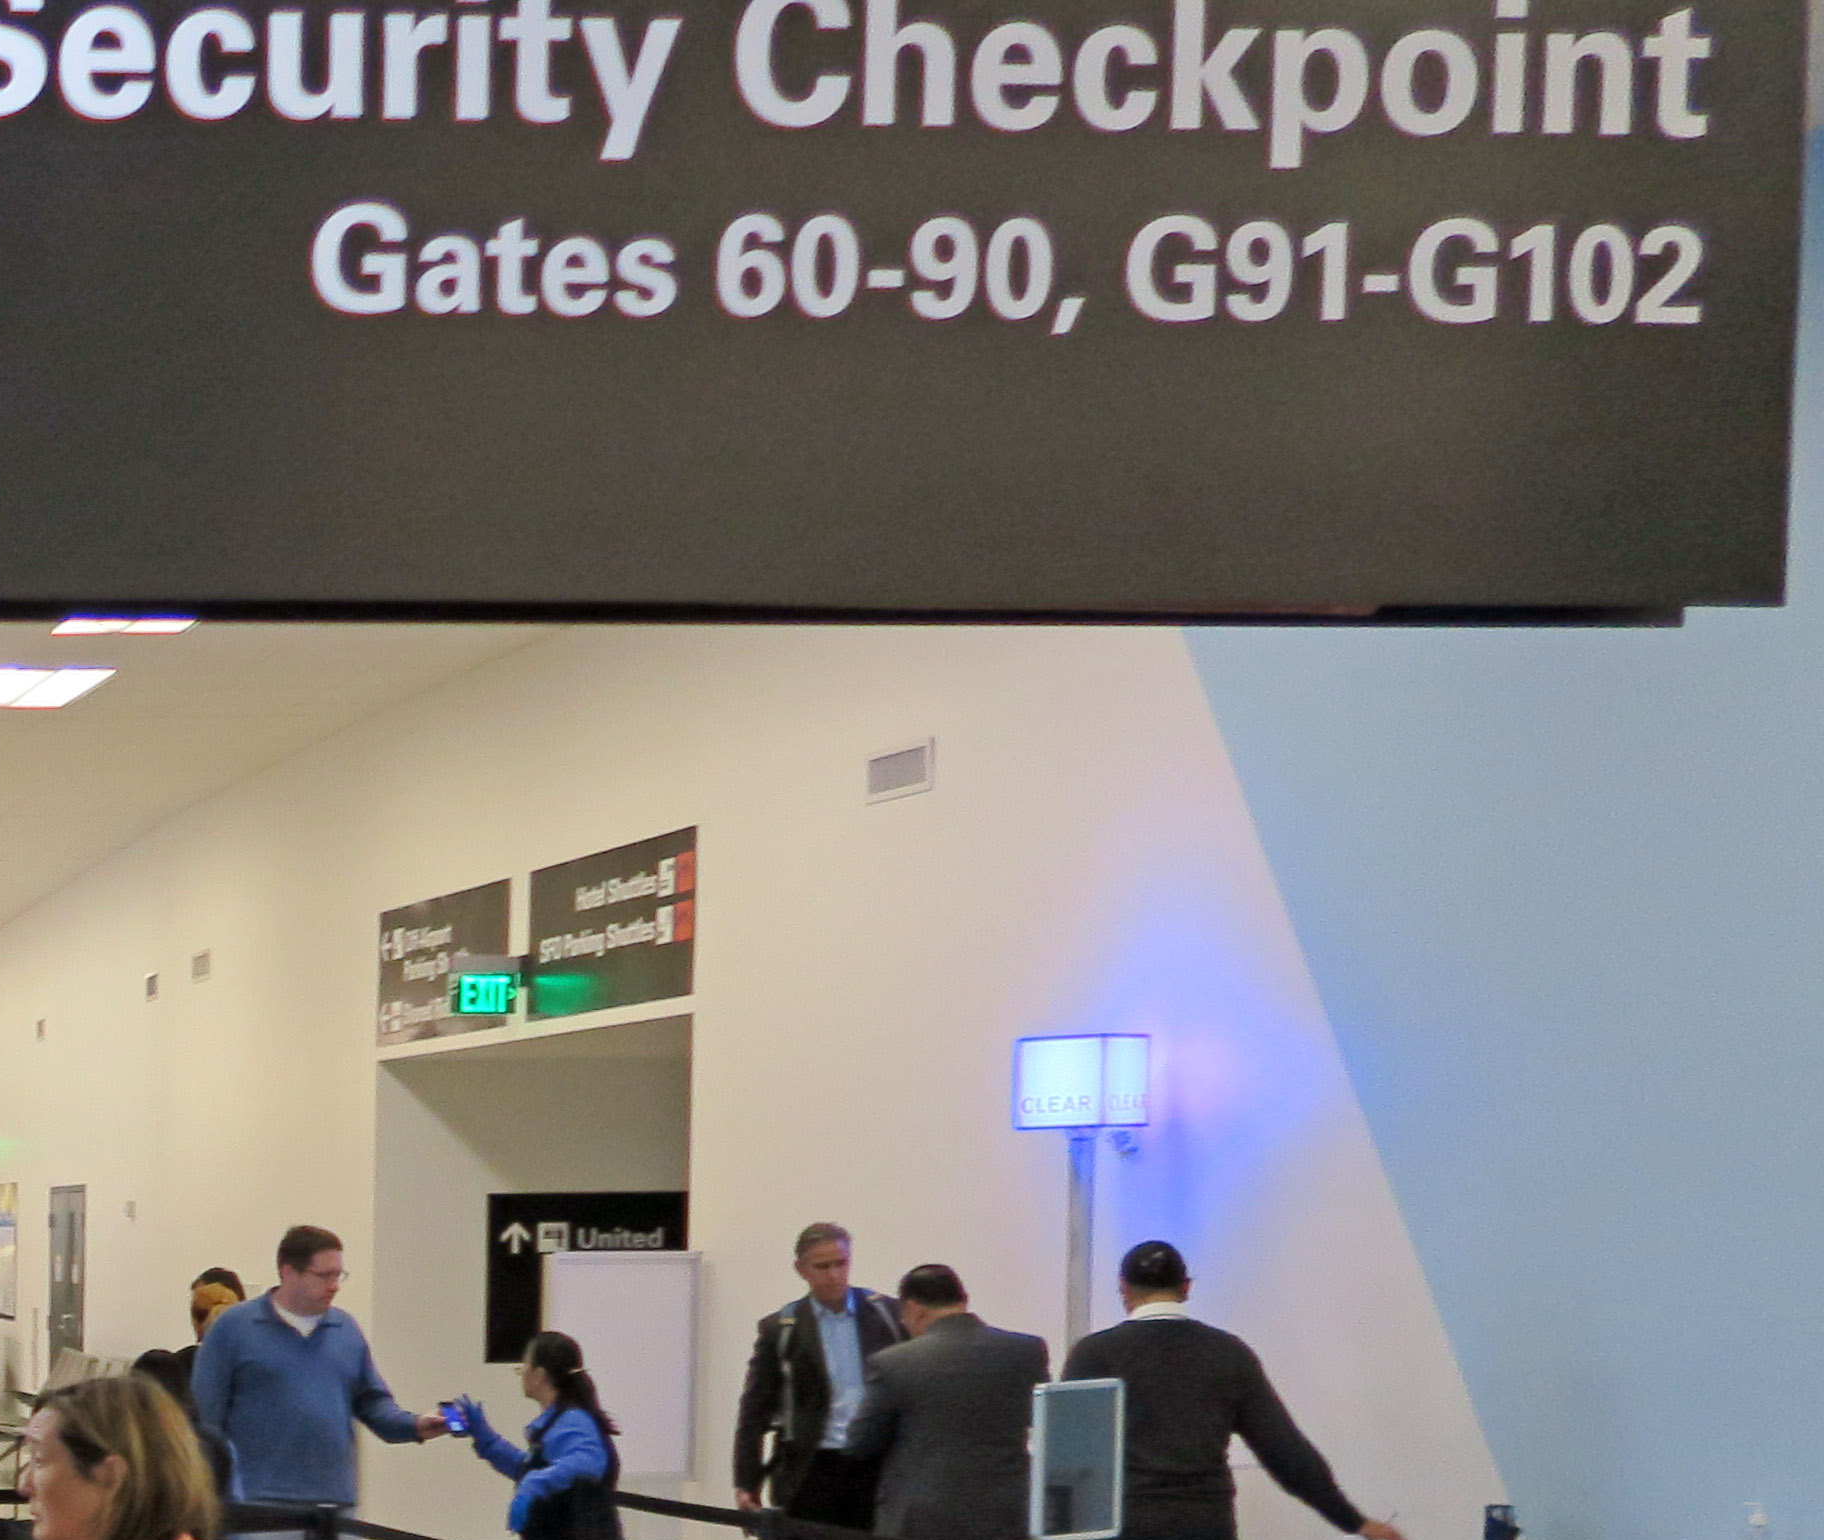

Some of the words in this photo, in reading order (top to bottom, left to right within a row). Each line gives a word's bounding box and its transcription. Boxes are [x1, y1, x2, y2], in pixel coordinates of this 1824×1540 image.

[734, 0, 1712, 169] Checkpoint
[311, 201, 679, 317] Gates
[715, 212, 1086, 335] 60-90,
[1124, 213, 1704, 326] G91-G102
[575, 881, 607, 911] Hotel
[539, 935, 563, 964] SFO
[563, 929, 606, 958] Parking
[460, 974, 512, 1013] EXIT
[1019, 1094, 1093, 1114] CLEAR
[576, 1226, 666, 1249] United
